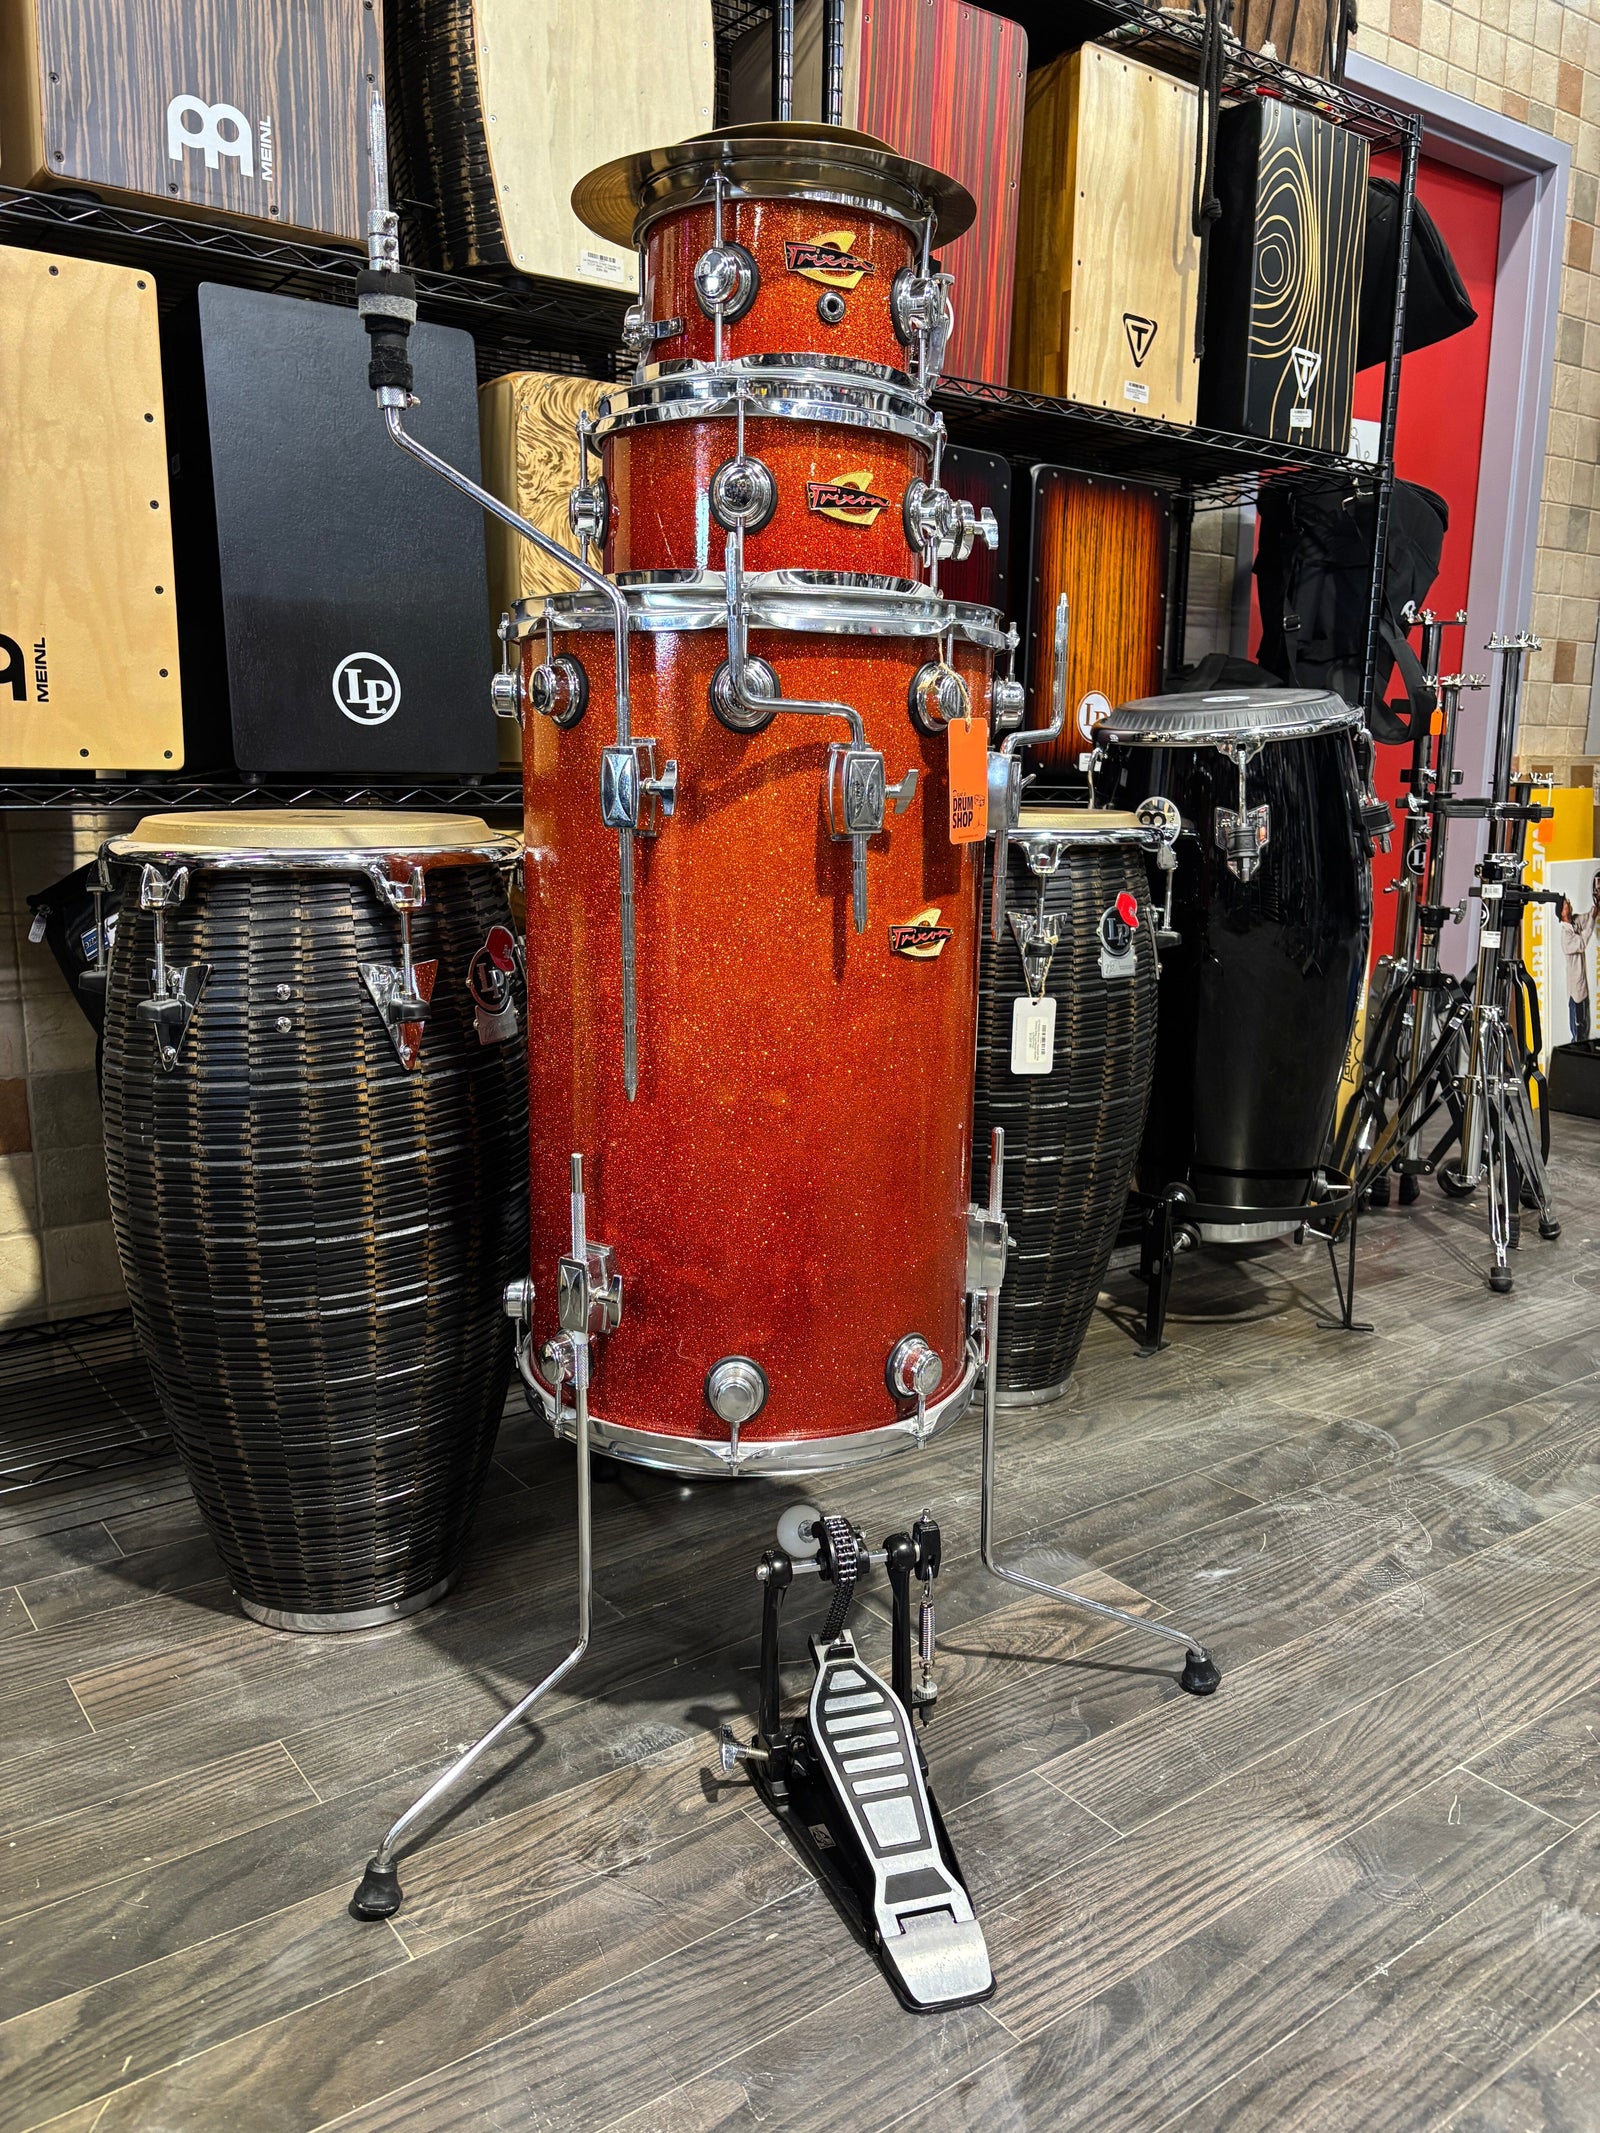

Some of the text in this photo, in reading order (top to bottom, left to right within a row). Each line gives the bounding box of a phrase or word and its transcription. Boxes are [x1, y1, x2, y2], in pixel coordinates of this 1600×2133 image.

[259, 115, 273, 181] MEINL
[787, 244, 873, 271] Trixon
[810, 484, 888, 508] Trixon
[33, 636, 50, 703] MEINL
[344, 668, 393, 714] LP
[953, 795, 973, 812] DRUM
[952, 811, 973, 829] SHOP
[893, 927, 951, 949] Trixon
[1106, 917, 1131, 946] LP
[476, 962, 505, 998] LP
